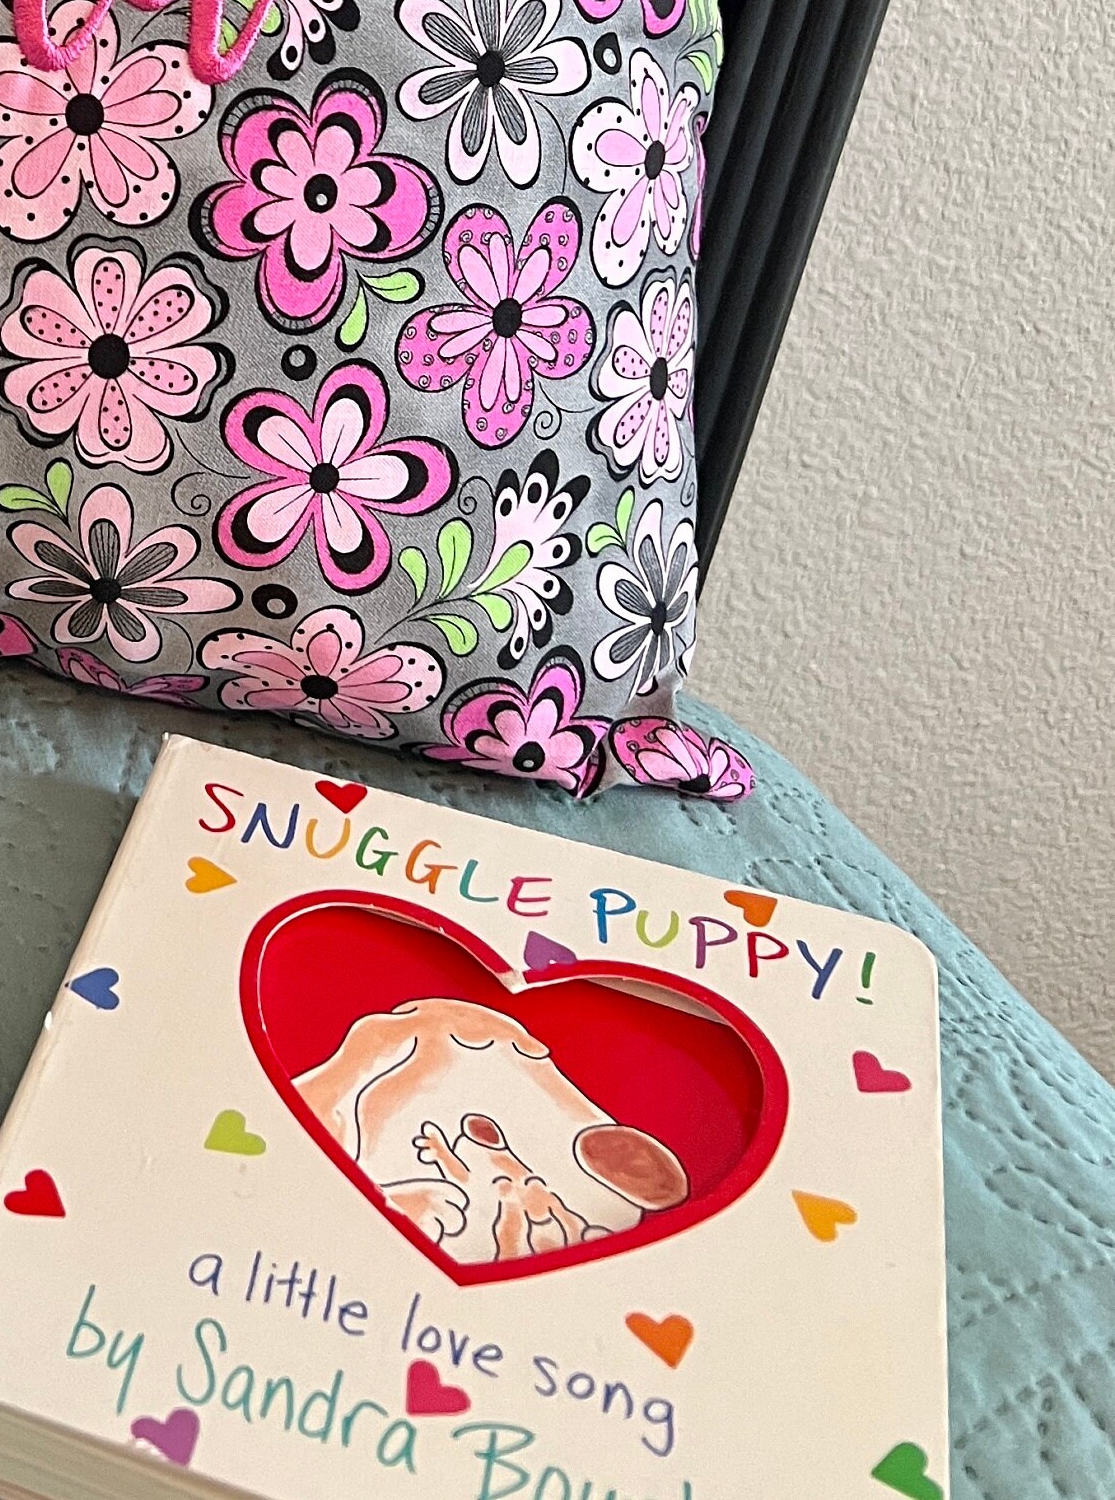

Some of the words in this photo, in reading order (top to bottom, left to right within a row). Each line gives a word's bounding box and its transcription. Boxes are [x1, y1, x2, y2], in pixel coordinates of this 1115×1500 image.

[198, 782, 553, 918] SNUGGLE
[590, 888, 876, 1005] PUPPY!
[65, 1283, 146, 1414] by
[176, 1317, 418, 1475] Sandra
[188, 1253, 223, 1297] a
[245, 1250, 370, 1337] little
[401, 1291, 505, 1379] love
[532, 1355, 675, 1458] song
